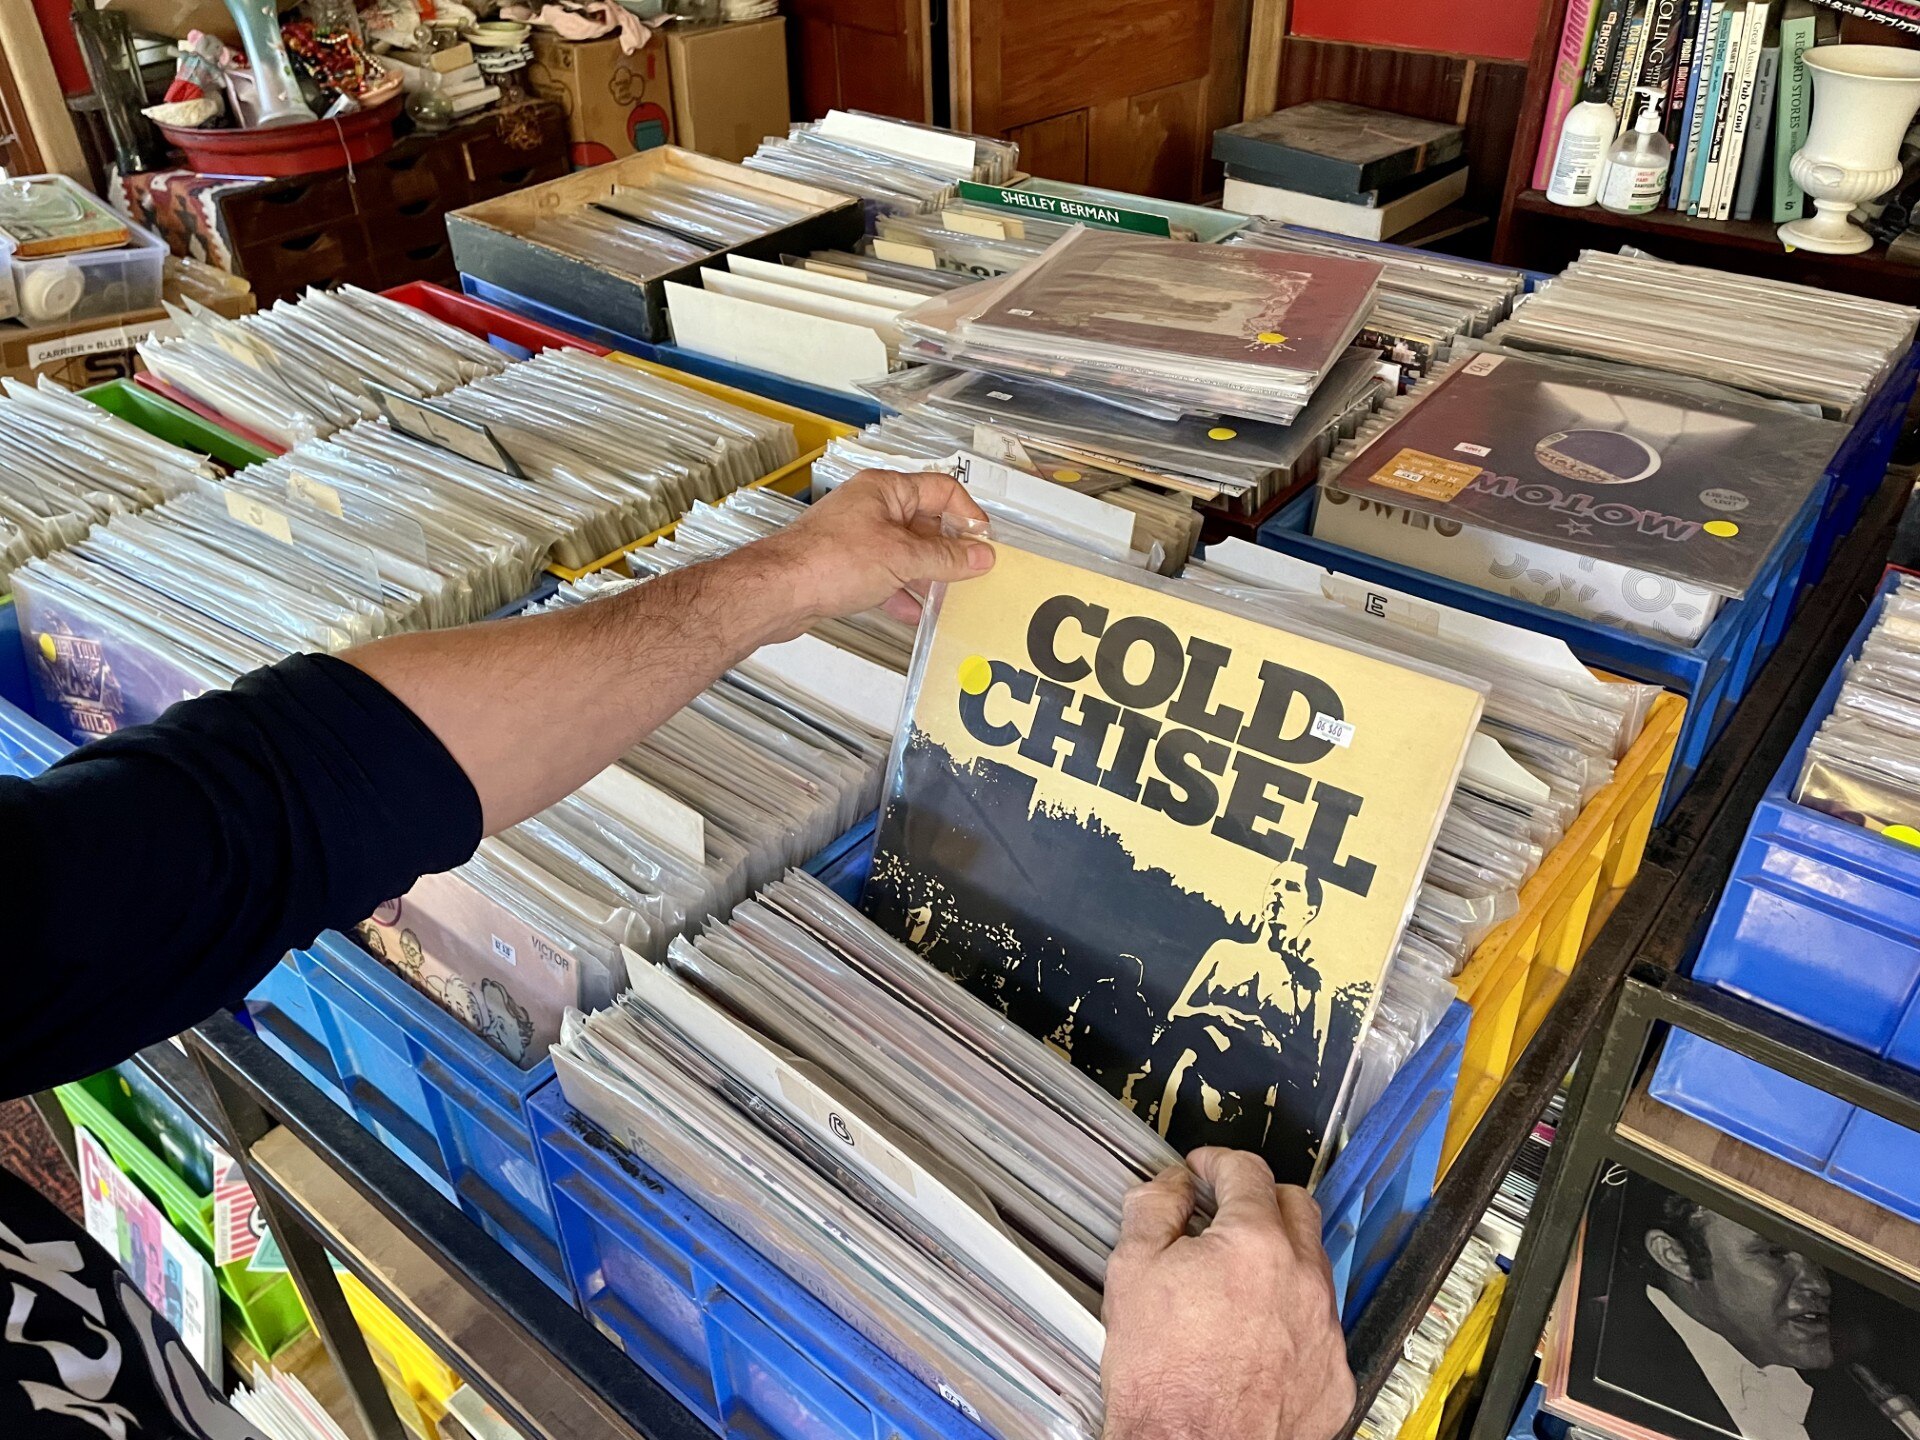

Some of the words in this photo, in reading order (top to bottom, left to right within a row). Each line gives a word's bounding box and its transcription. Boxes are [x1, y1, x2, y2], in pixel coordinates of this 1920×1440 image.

[1693, 10, 1708, 68] PINBALL
[1703, 10, 1720, 71] VINTAGE
[1752, 21, 1764, 46] Great
[1744, 49, 1756, 78] Aussie
[1793, 31, 1806, 82] RECORD
[1740, 80, 1751, 100] Pub
[1789, 82, 1803, 129] STORES
[1689, 77, 1709, 154] JUKEBOXES
[1734, 103, 1746, 133] Crawl
[1001, 189, 1057, 214] SHELLEY
[1060, 199, 1121, 225] BERMAN
[38, 344, 86, 361] CARRIER
[96, 338, 126, 350] BLUE
[1464, 469, 1701, 542] MOTOW
[1364, 592, 1388, 618] E
[1026, 594, 1346, 765] COLD
[958, 659, 1378, 898] CHISEL
[531, 936, 571, 972] VICTOR
